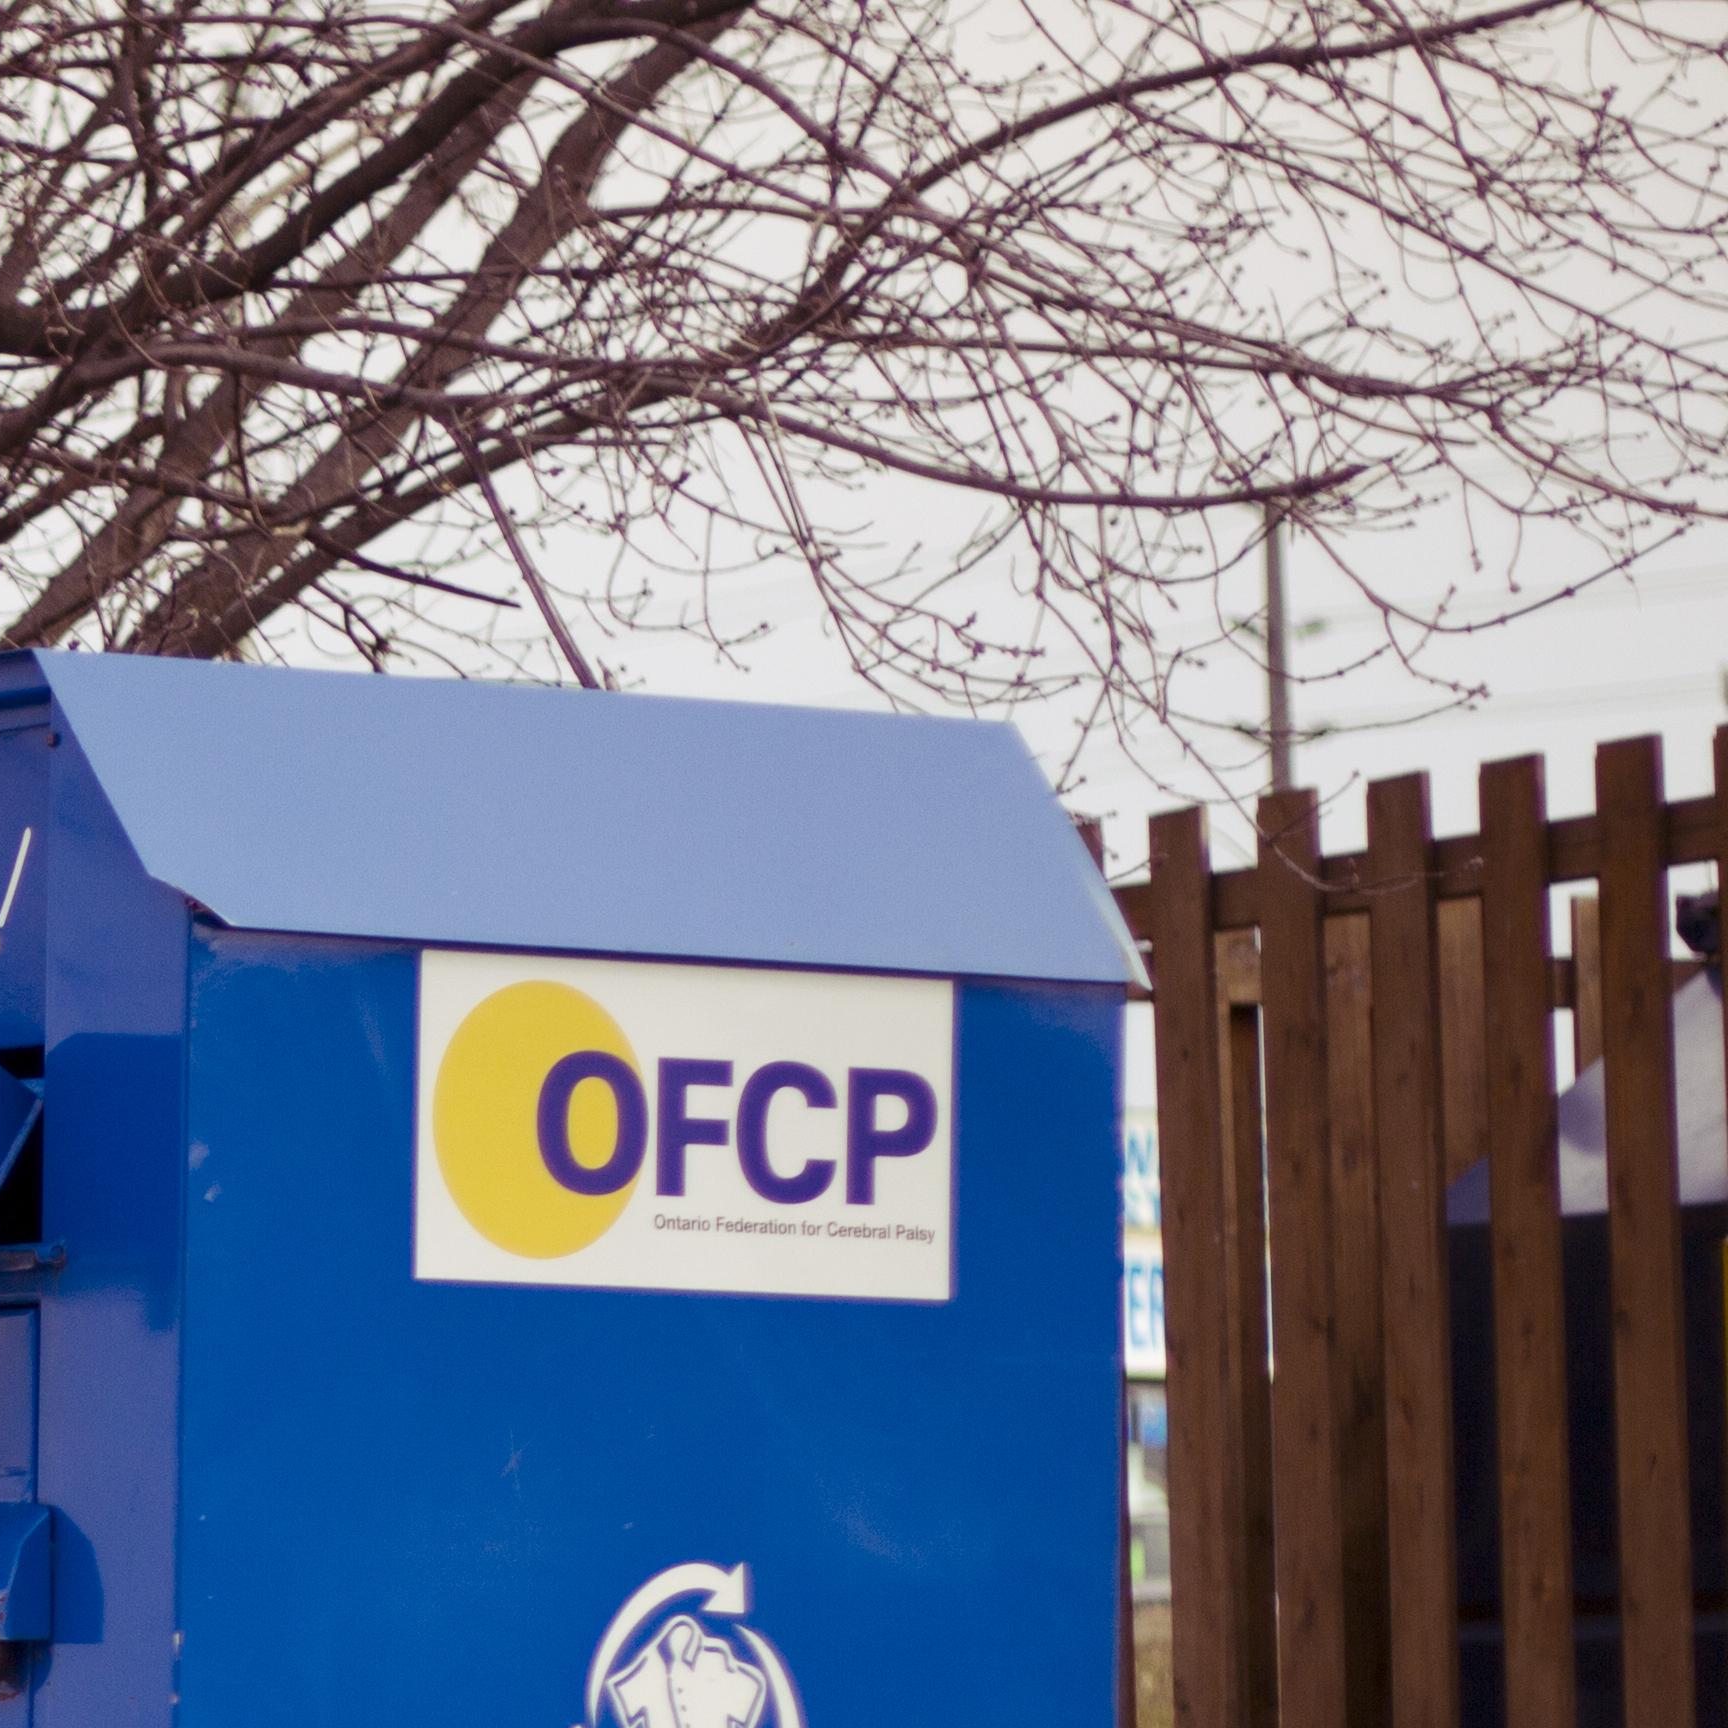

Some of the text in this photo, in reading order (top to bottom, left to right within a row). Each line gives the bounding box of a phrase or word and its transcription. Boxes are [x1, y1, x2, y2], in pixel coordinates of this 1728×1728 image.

[537, 1050, 938, 1206] OFCP
[654, 1213, 936, 1245] Ontario Federation for Cerebral Palsy
